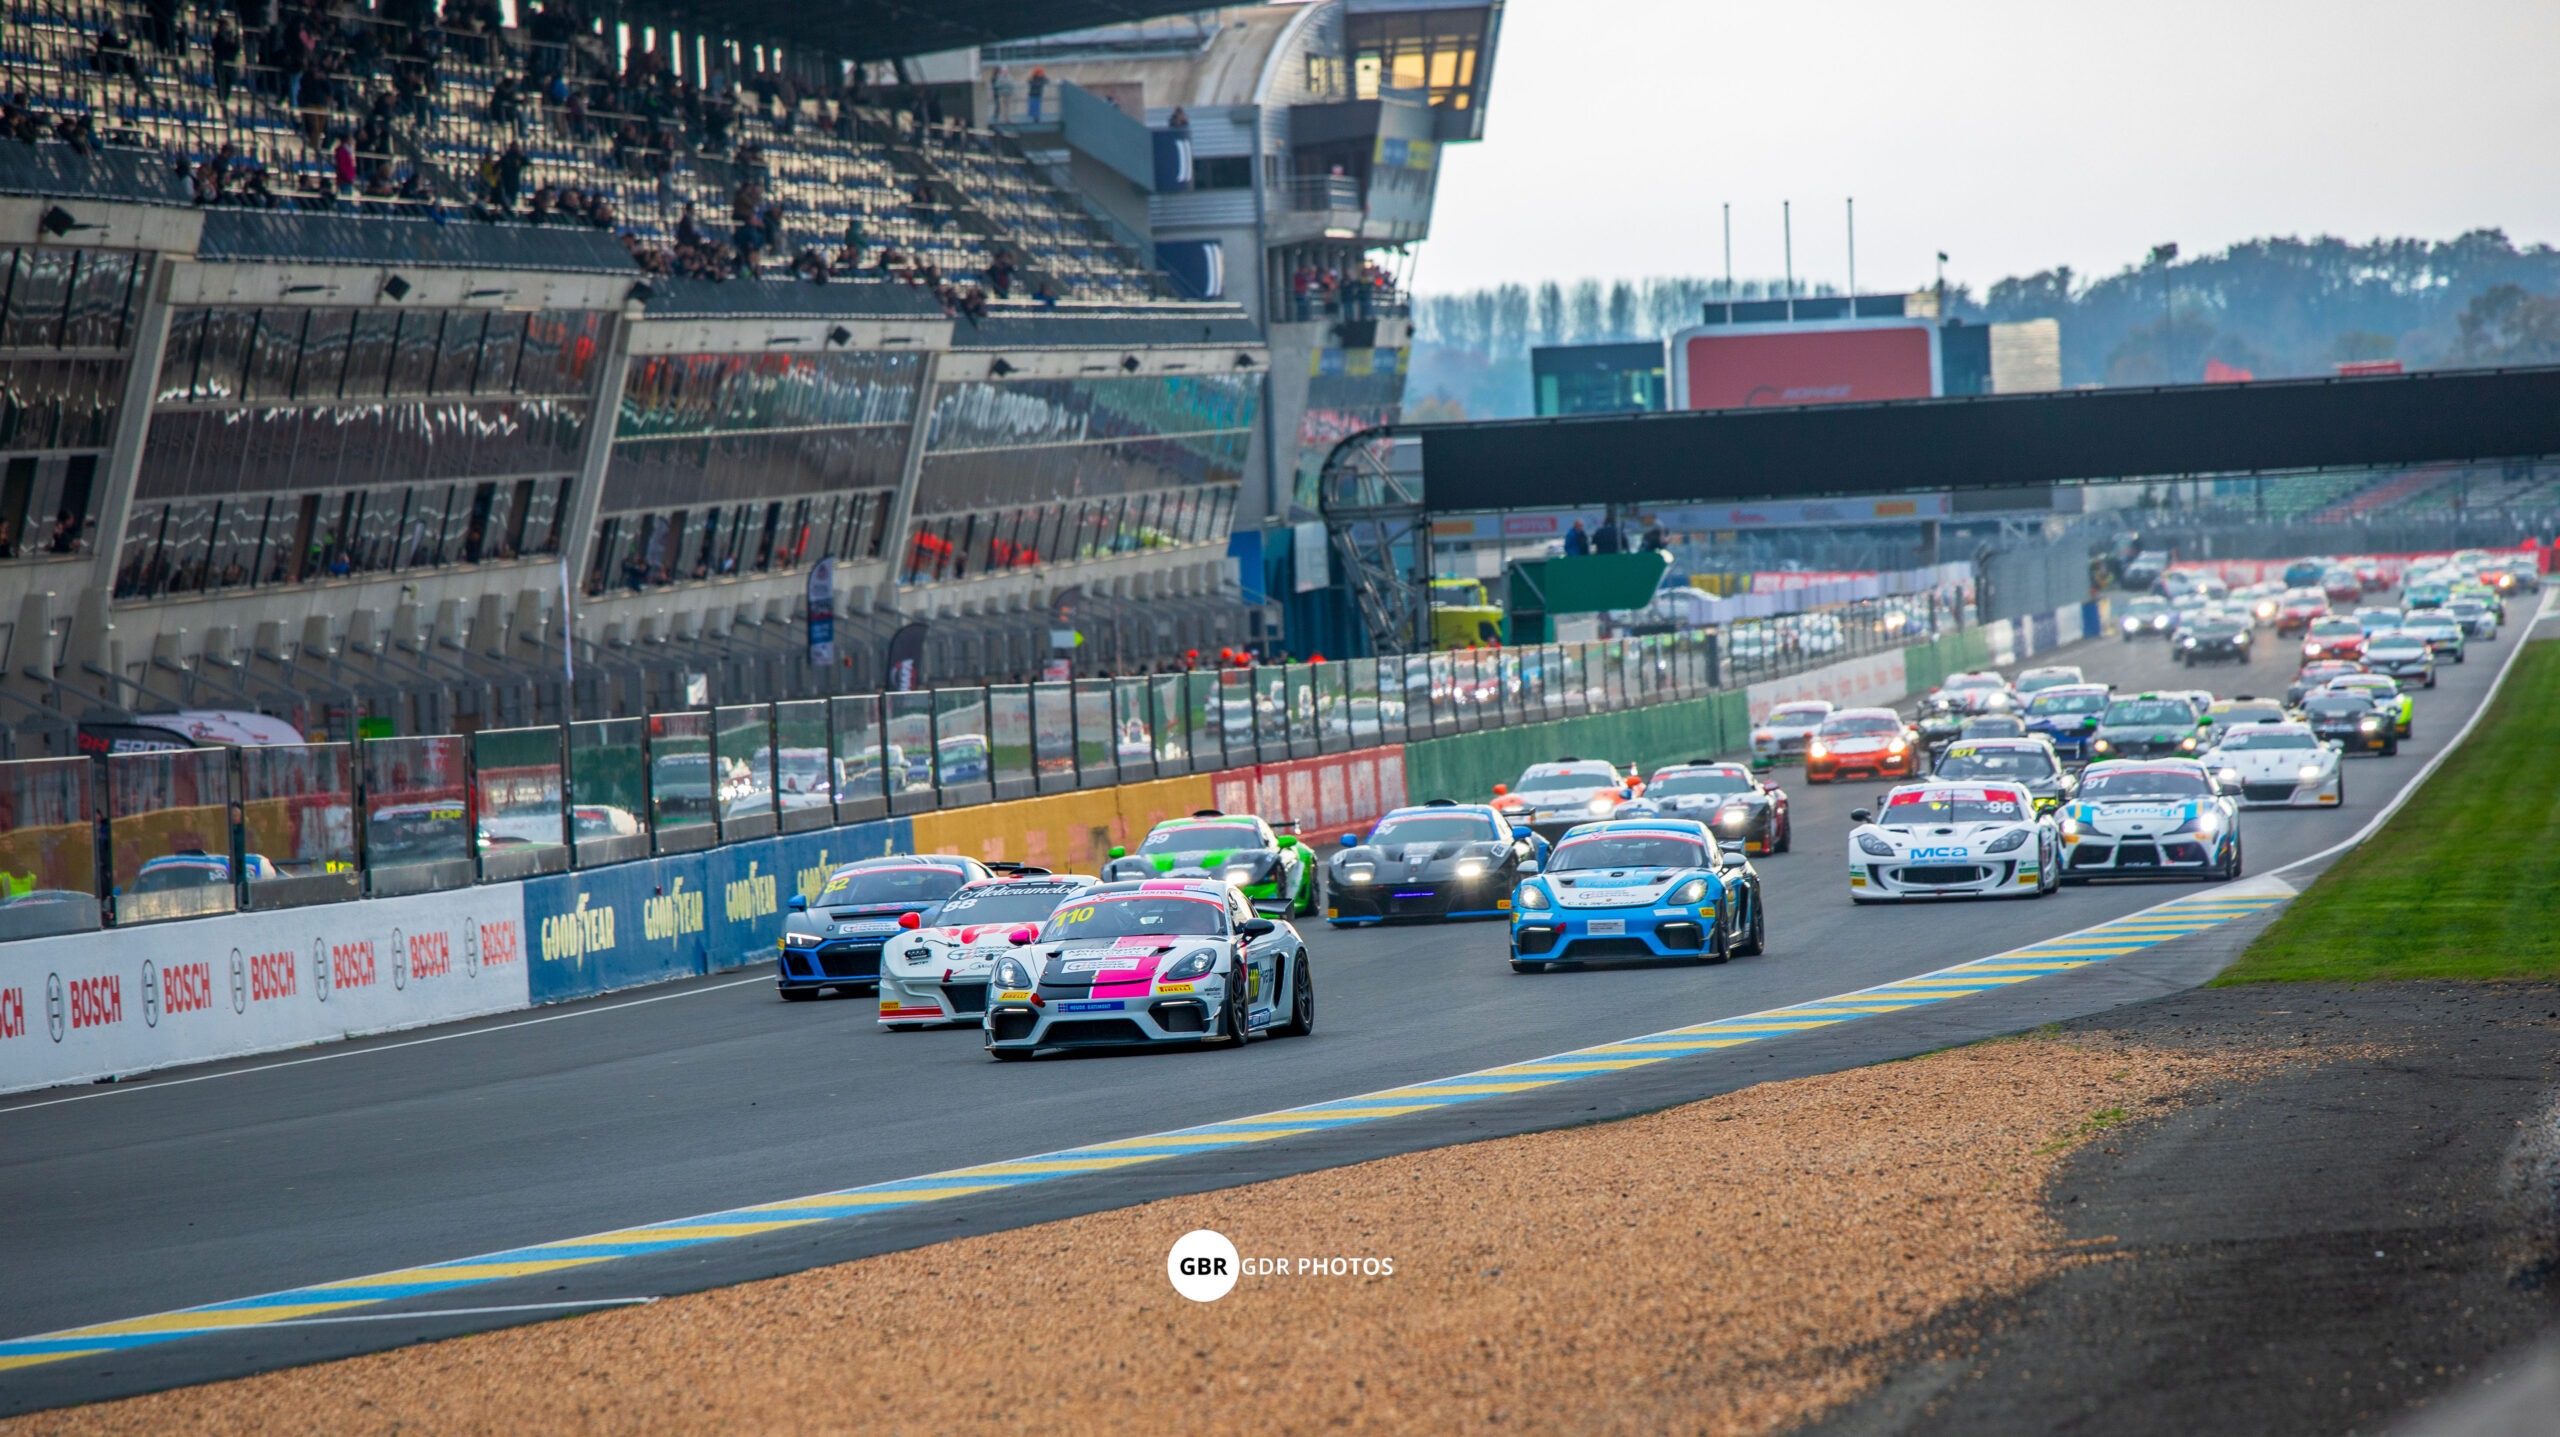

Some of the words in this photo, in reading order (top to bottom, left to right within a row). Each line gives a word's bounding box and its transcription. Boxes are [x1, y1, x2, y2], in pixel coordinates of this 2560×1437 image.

[2085, 776, 2110, 790] 91
[1988, 801, 2015, 814] 96
[1145, 833, 1170, 846] 99
[725, 873, 777, 924] GOODYEAR
[824, 877, 849, 893] 82
[942, 898, 978, 914] 88
[541, 905, 615, 962] GOODYEAR
[644, 890, 704, 942] GOODYEAR
[1054, 906, 1095, 928] 110
[332, 940, 376, 989] BOSCH
[409, 931, 450, 979] BOSCH
[481, 921, 517, 966] BOSCH
[162, 962, 212, 1014] BOSCH
[251, 951, 296, 1001] BOSCH
[1001, 992, 1029, 1000] PIRELLI
[1159, 984, 1191, 993] PIRELLI
[70, 975, 122, 1029] BOSCH
